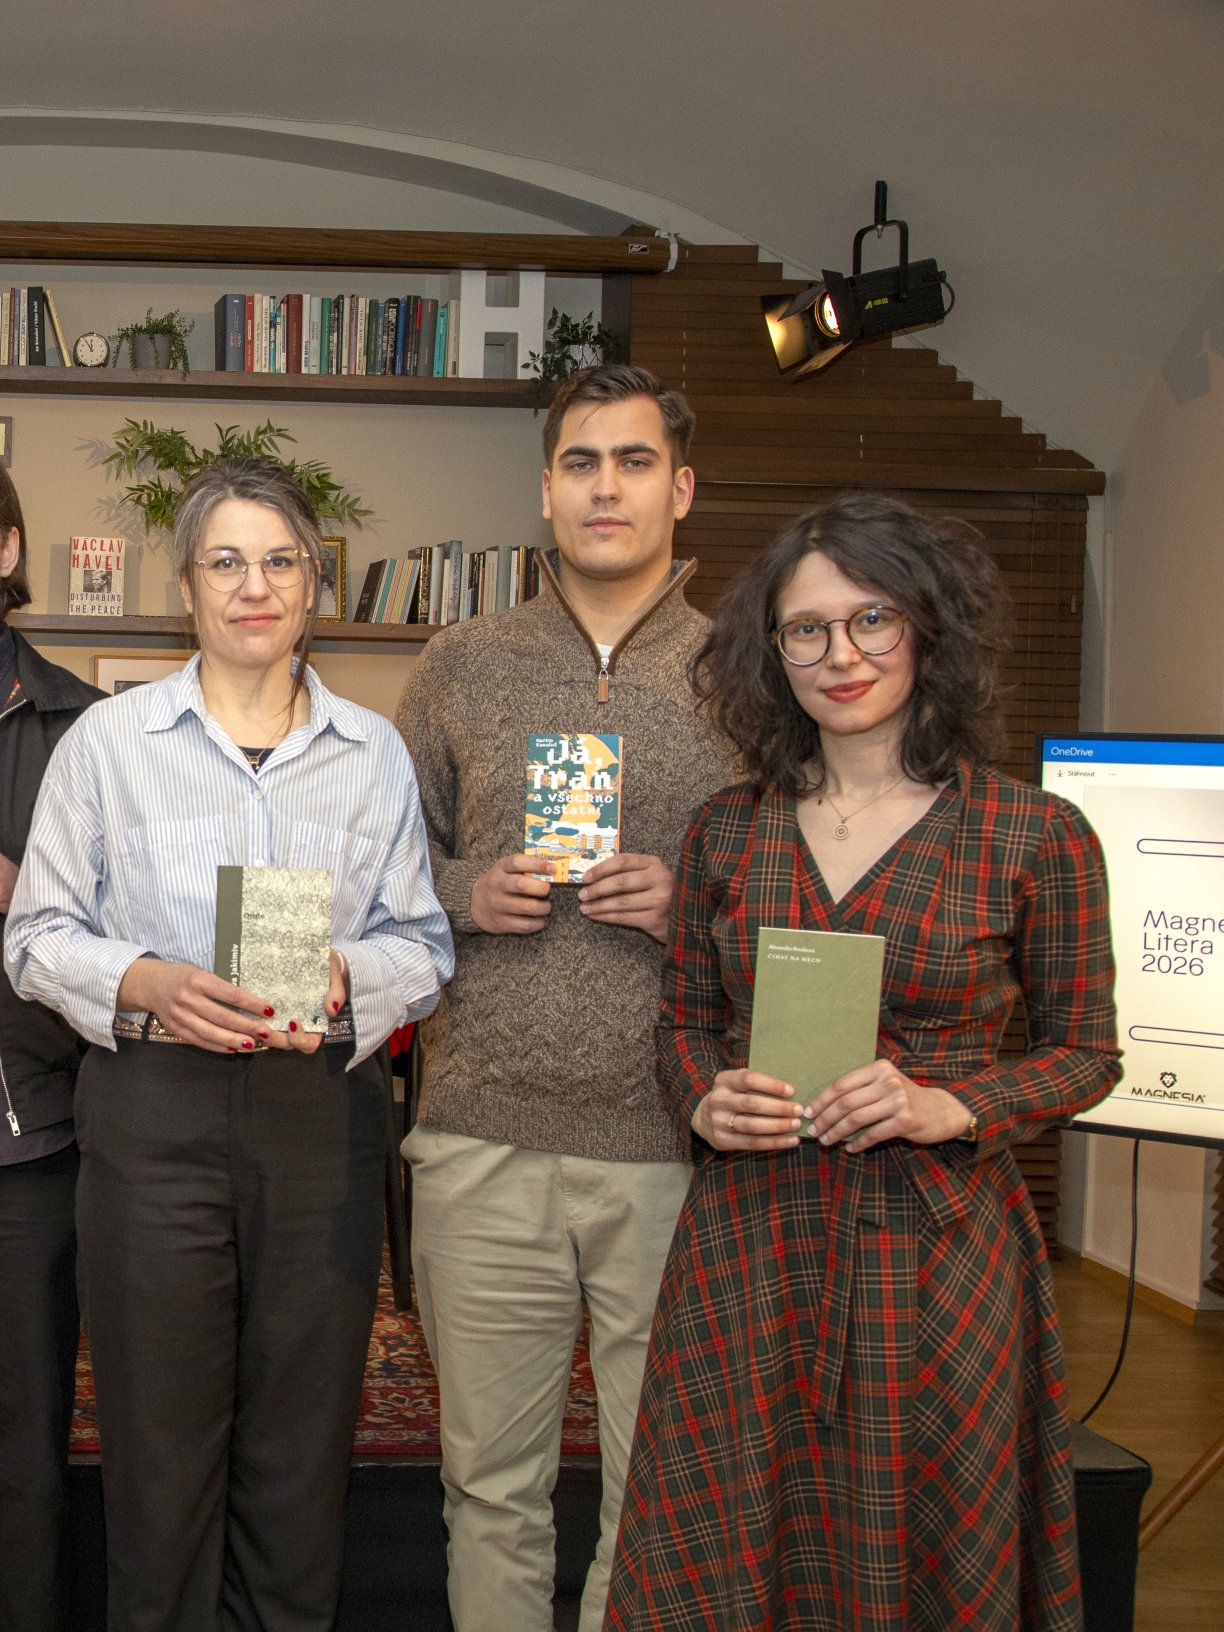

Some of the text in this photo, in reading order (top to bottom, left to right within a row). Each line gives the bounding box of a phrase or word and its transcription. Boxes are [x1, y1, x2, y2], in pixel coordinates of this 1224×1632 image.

[72, 537, 124, 554] VÁCLAV
[71, 553, 123, 571] HAVEL
[70, 592, 122, 603] DISTURBING
[70, 604, 122, 615] THE PEACE
[547, 737, 604, 769] Já,
[1050, 746, 1094, 758] OneDrive
[528, 764, 613, 791] Tran
[1067, 768, 1096, 779] Stáhnout
[533, 791, 614, 804] a všechno
[542, 804, 602, 816] ostatní
[1143, 931, 1215, 955] Litera
[1141, 953, 1205, 977] 2026
[1130, 1086, 1206, 1104] MAGNESIA
